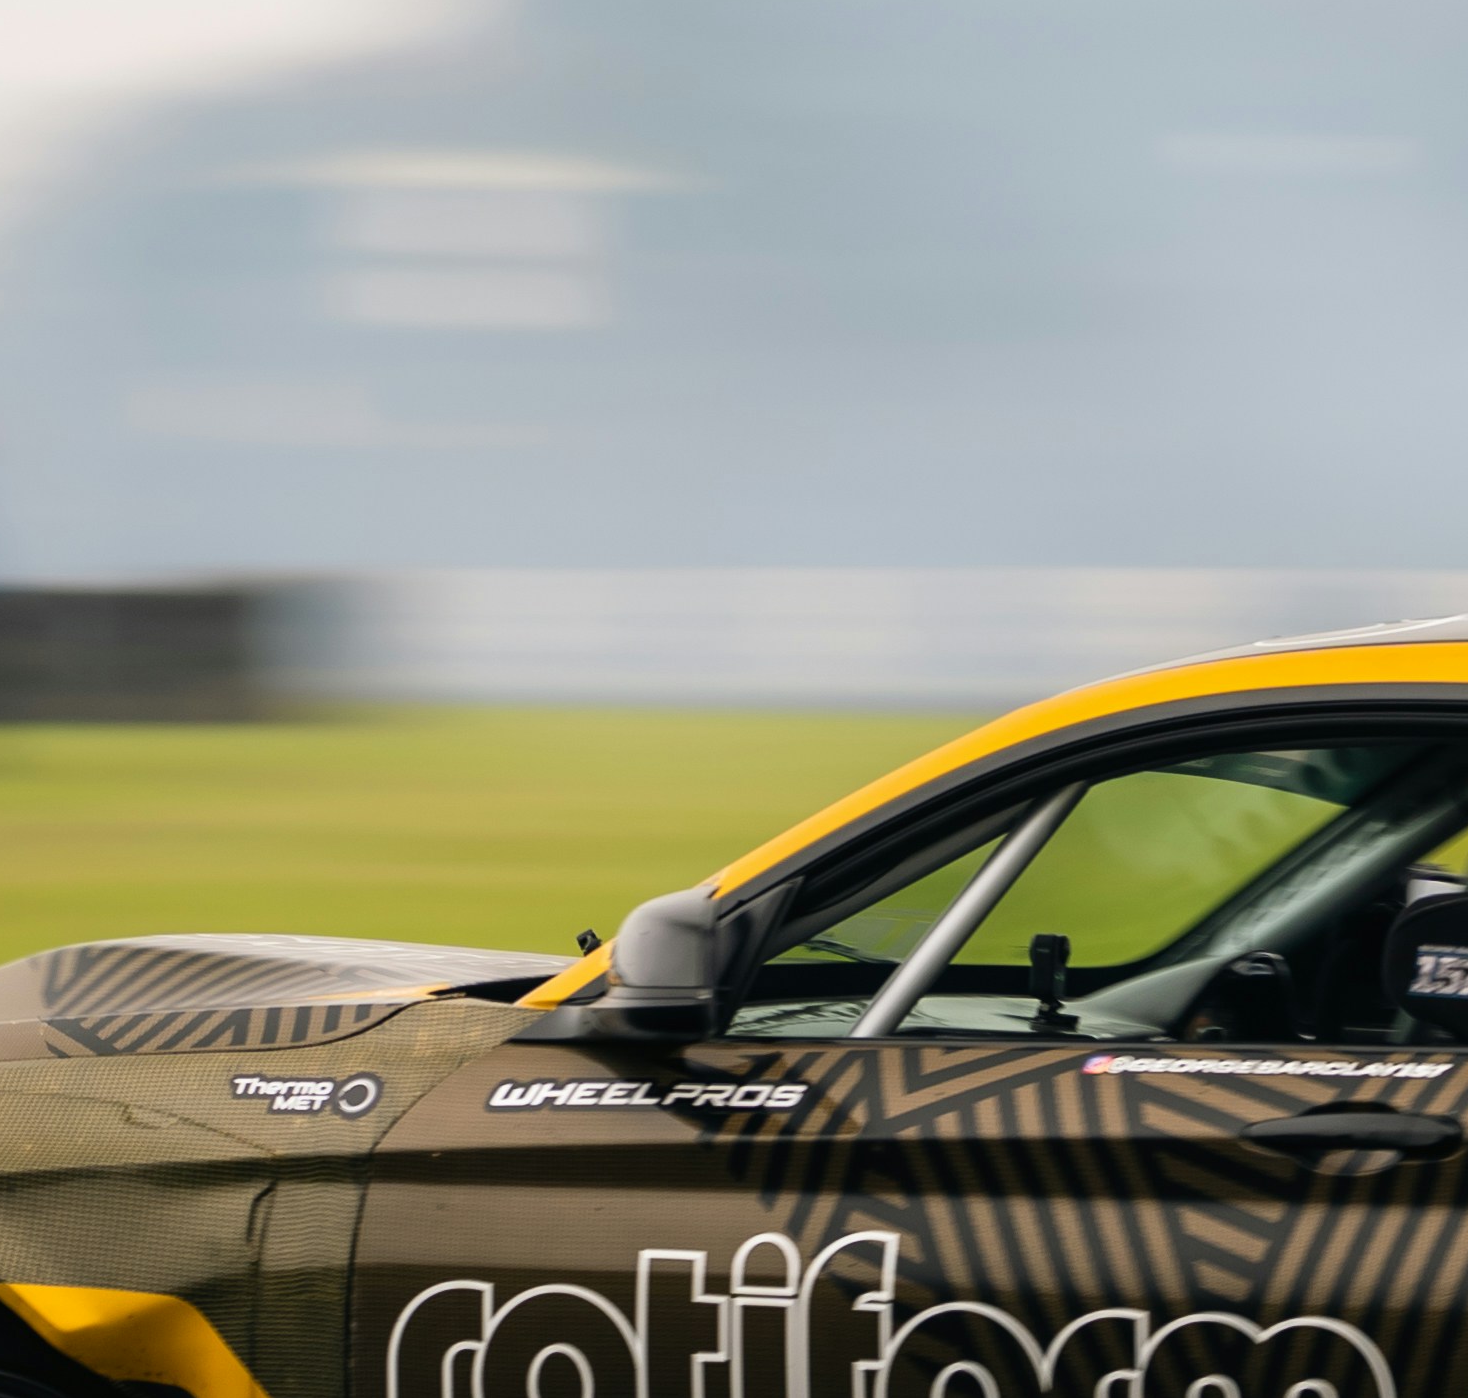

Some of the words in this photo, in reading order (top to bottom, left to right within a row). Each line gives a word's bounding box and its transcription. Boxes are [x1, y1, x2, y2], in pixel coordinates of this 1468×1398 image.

[233, 1076, 334, 1096] Thermo
[489, 1082, 660, 1106] WHEEL
[662, 1083, 809, 1108] PROS
[271, 1095, 331, 1111] MET
